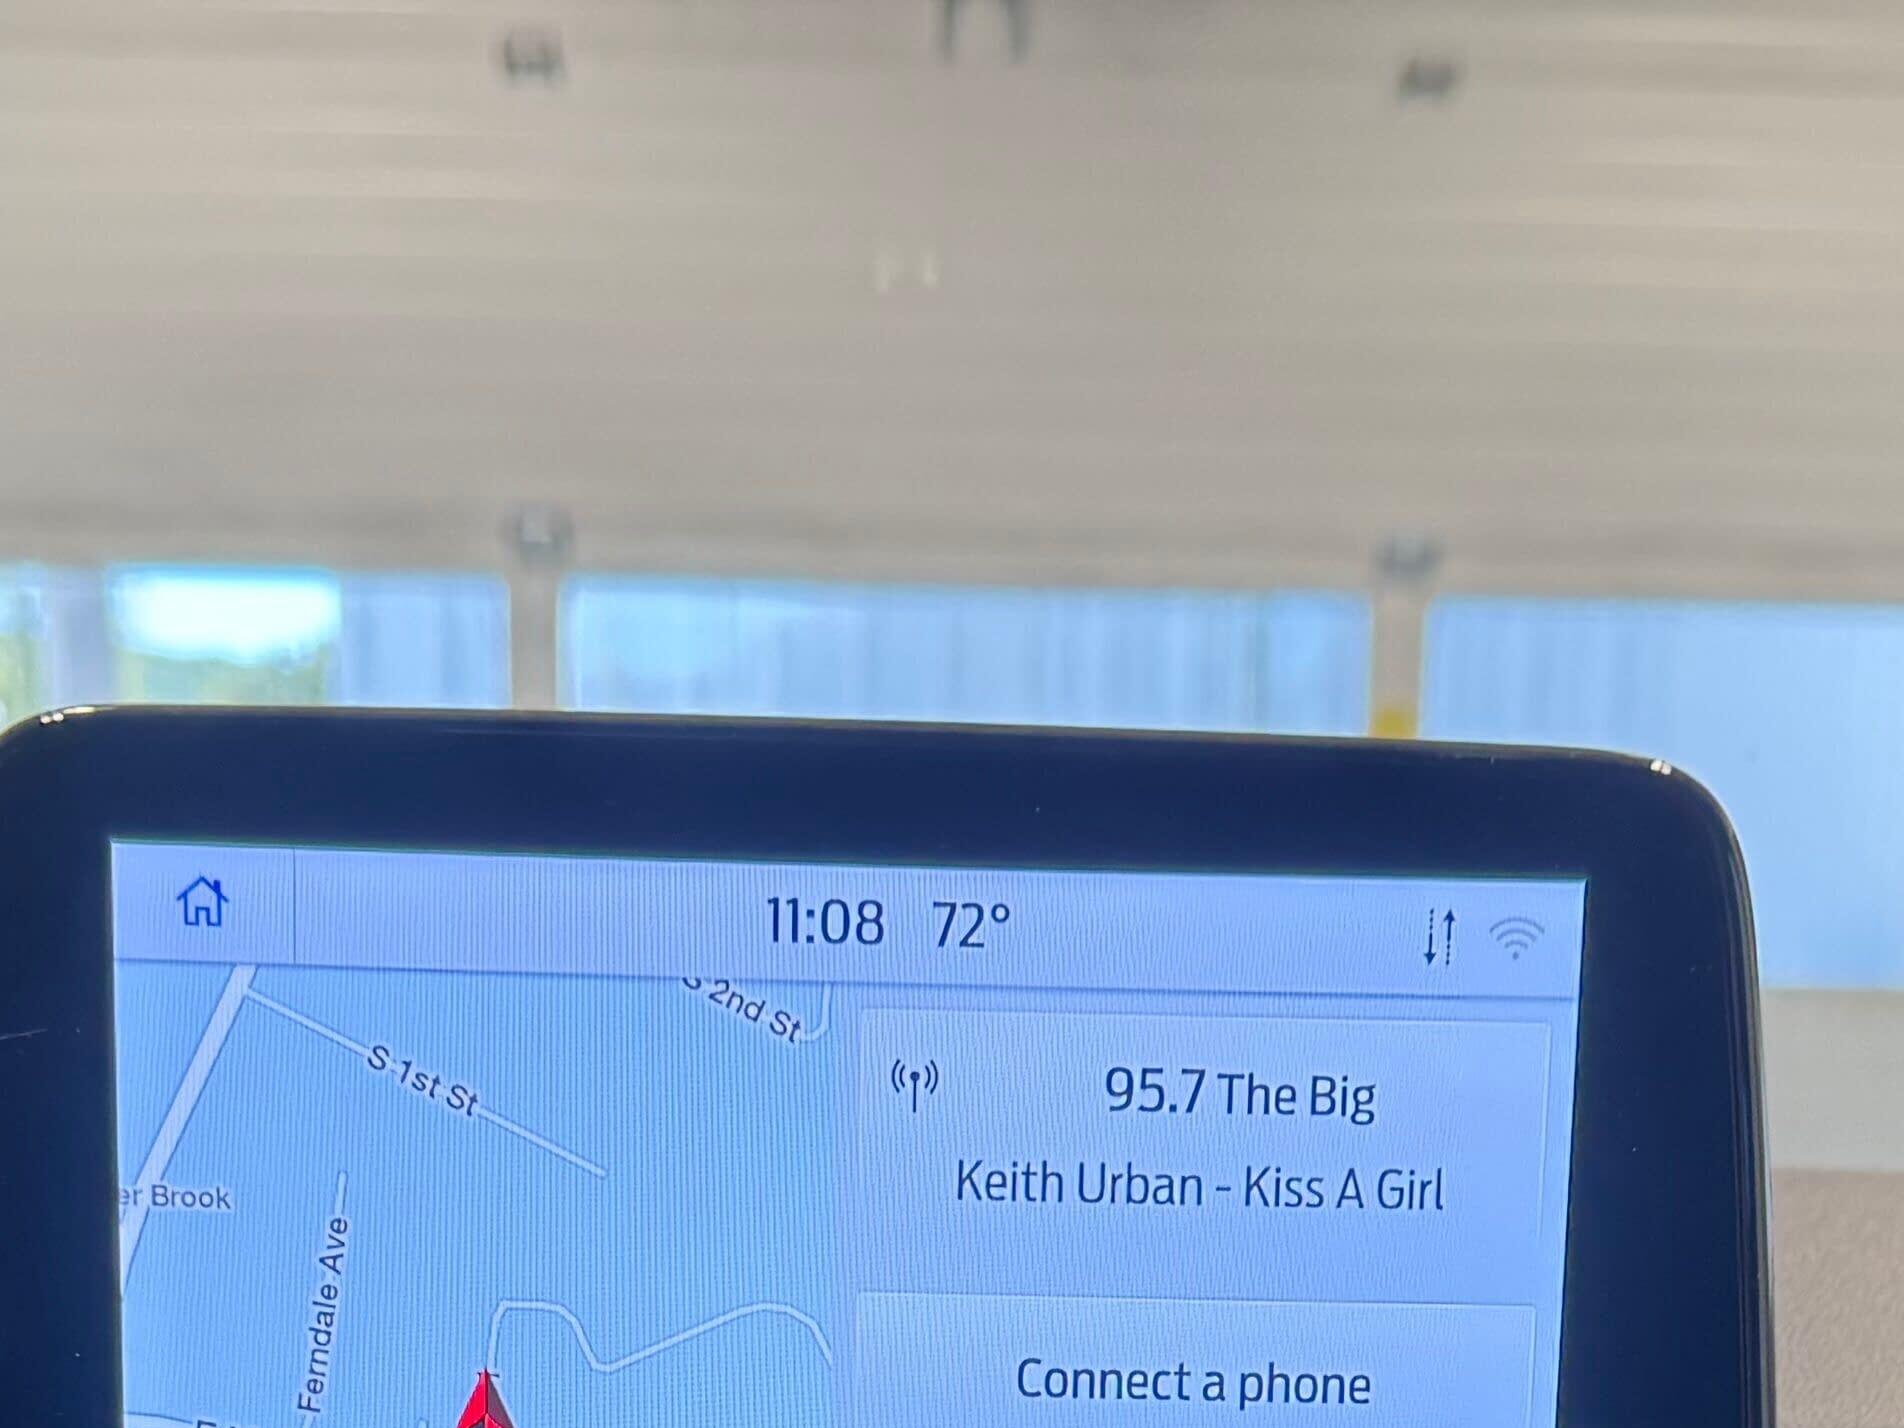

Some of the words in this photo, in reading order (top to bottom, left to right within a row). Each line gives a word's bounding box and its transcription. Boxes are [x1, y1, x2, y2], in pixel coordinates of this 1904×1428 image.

[768, 895, 884, 945] 11:08
[932, 901, 1011, 948] 72°
[708, 978, 766, 1022] 2nd
[769, 1009, 801, 1043] St
[367, 1045, 390, 1071] S
[400, 1060, 441, 1099] 1st
[446, 1084, 478, 1117] St
[1106, 1067, 1206, 1114] 95.7
[1217, 1072, 1297, 1116] The
[1310, 1074, 1376, 1125] Big
[151, 1184, 231, 1209] Brook
[957, 1159, 1064, 1203] Keith
[1078, 1162, 1202, 1206] Urban
[1245, 1166, 1324, 1210] Kiss
[1336, 1168, 1364, 1210] A
[1377, 1168, 1444, 1211] Girl
[297, 1284, 338, 1413] Ferndale
[318, 1217, 348, 1275] Ave
[1017, 1357, 1192, 1402] Connect
[1202, 1369, 1227, 1402] a
[1239, 1361, 1372, 1410] phone
